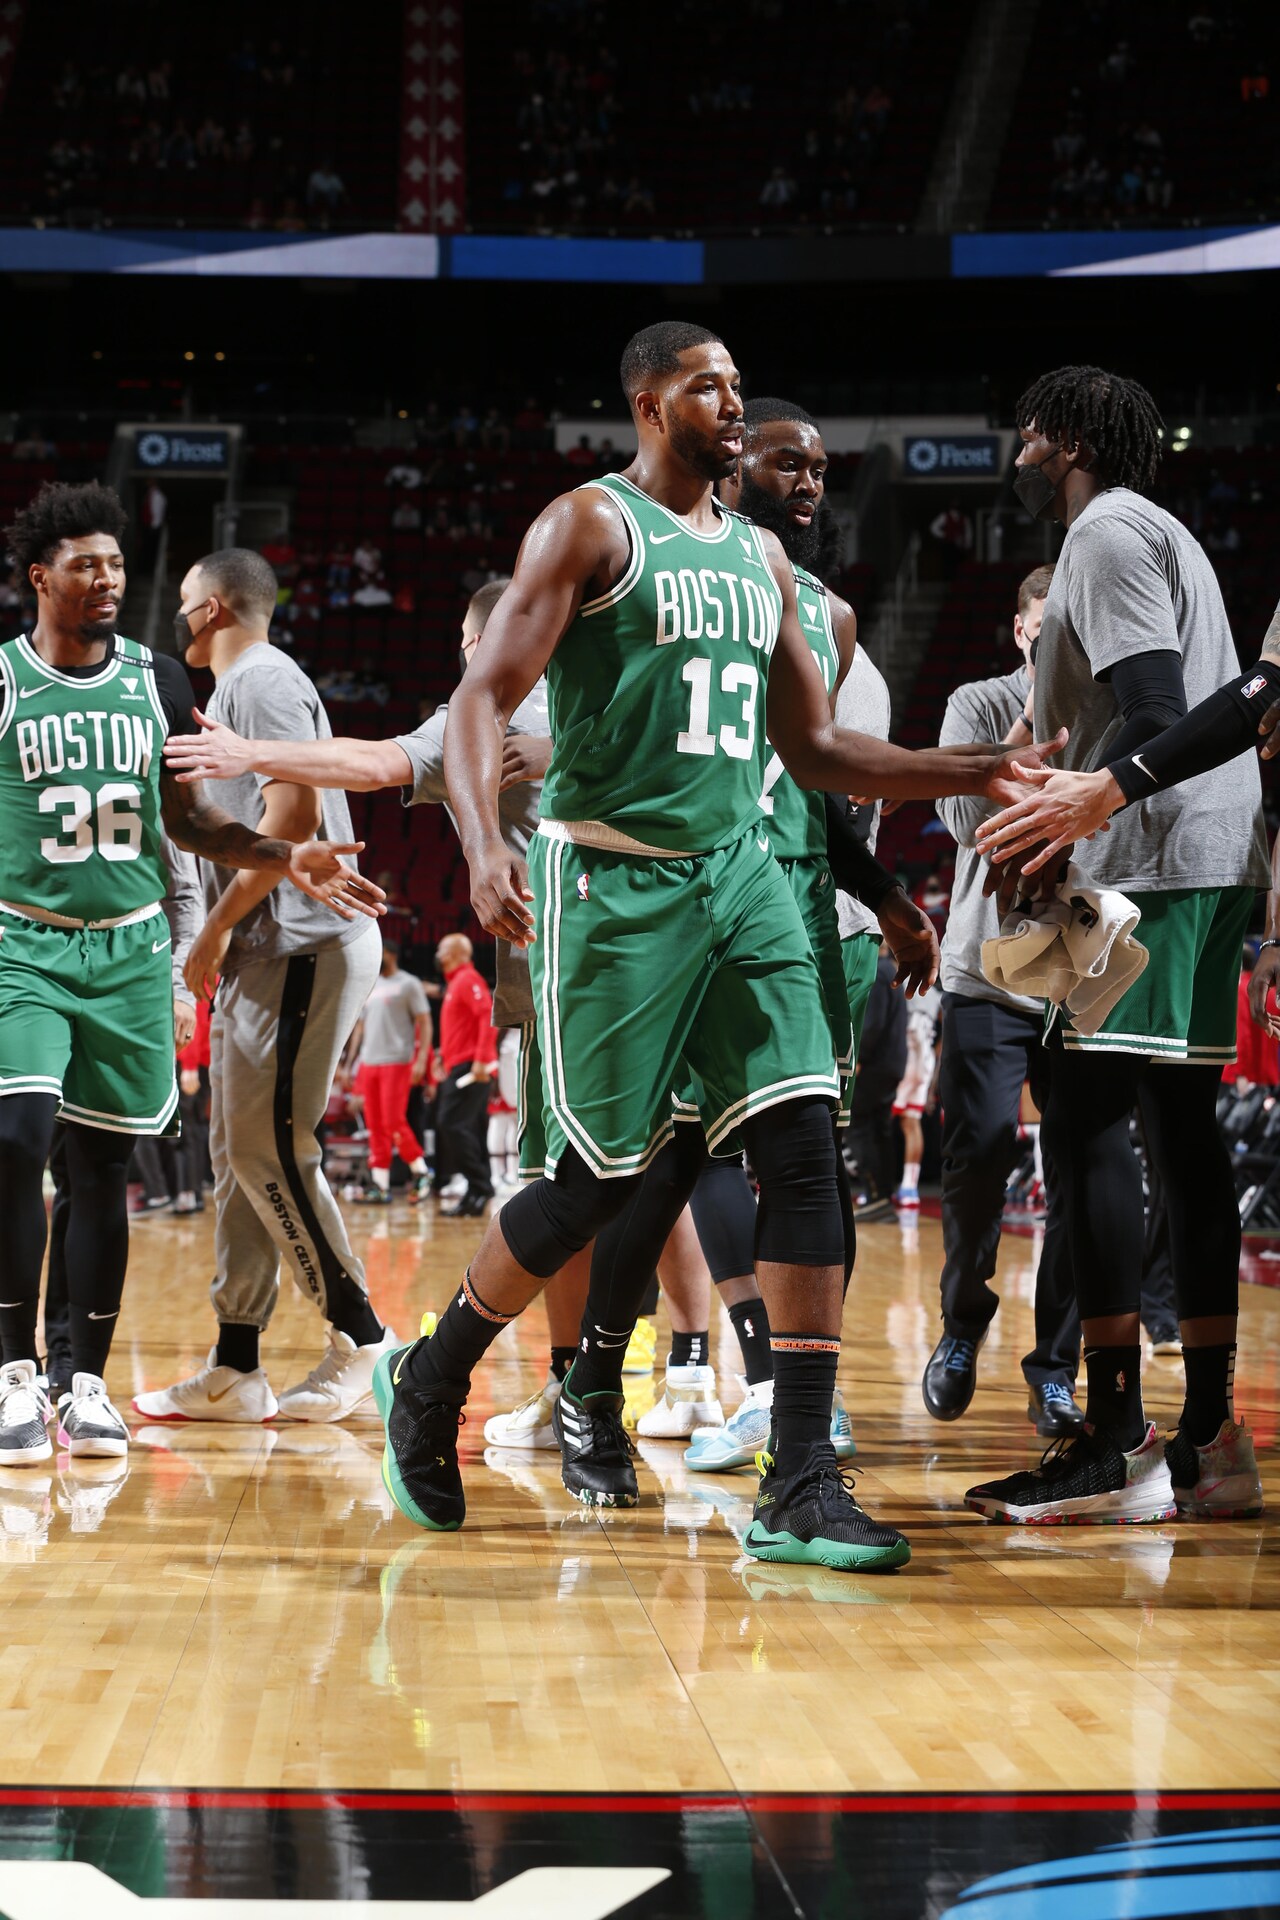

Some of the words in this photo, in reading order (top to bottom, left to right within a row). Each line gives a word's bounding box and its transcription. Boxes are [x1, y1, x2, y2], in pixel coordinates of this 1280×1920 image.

[654, 568, 778, 656] BOSTON
[16, 711, 154, 782] BOSTON
[676, 657, 759, 760] 13
[38, 783, 143, 863] 36
[265, 1182, 299, 1241] BOSTON
[294, 1244, 320, 1294] CELTICS
